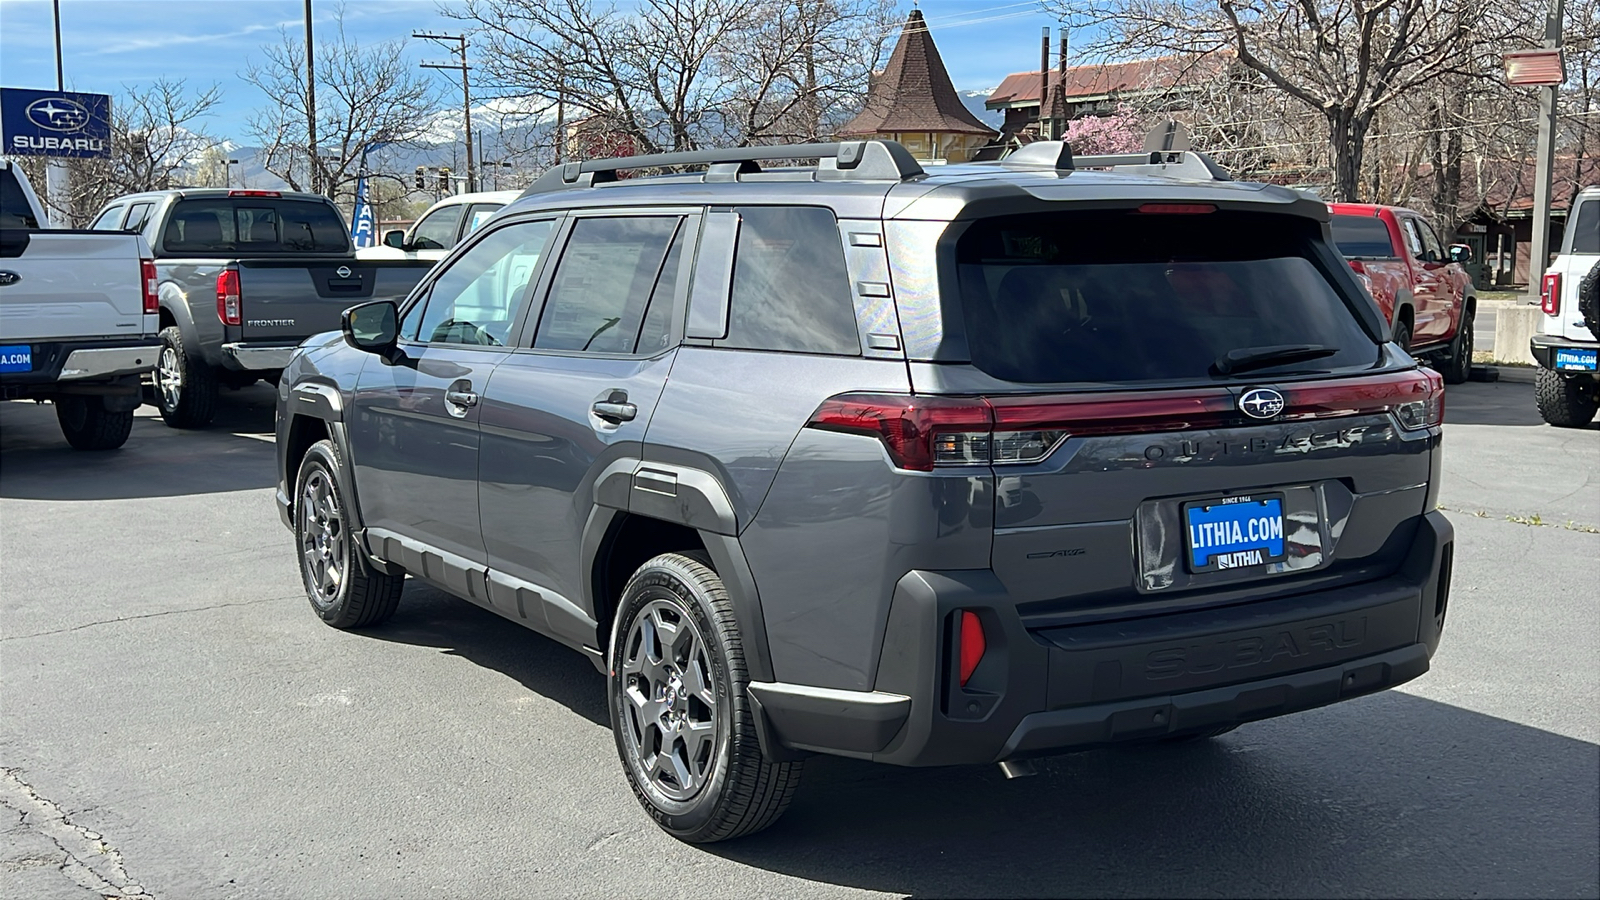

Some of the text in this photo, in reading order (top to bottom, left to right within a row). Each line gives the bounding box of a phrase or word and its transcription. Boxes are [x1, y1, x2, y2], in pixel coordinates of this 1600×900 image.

[13, 135, 103, 151] SUBARU
[247, 319, 295, 327] FRONTIER
[1556, 353, 1597, 364] LITHIA.COM
[1144, 429, 1350, 461] OUTBACK
[1190, 516, 1283, 549] LITHIA.COM
[1228, 550, 1263, 568] LITHIA
[1146, 616, 1368, 681] SUBARU
